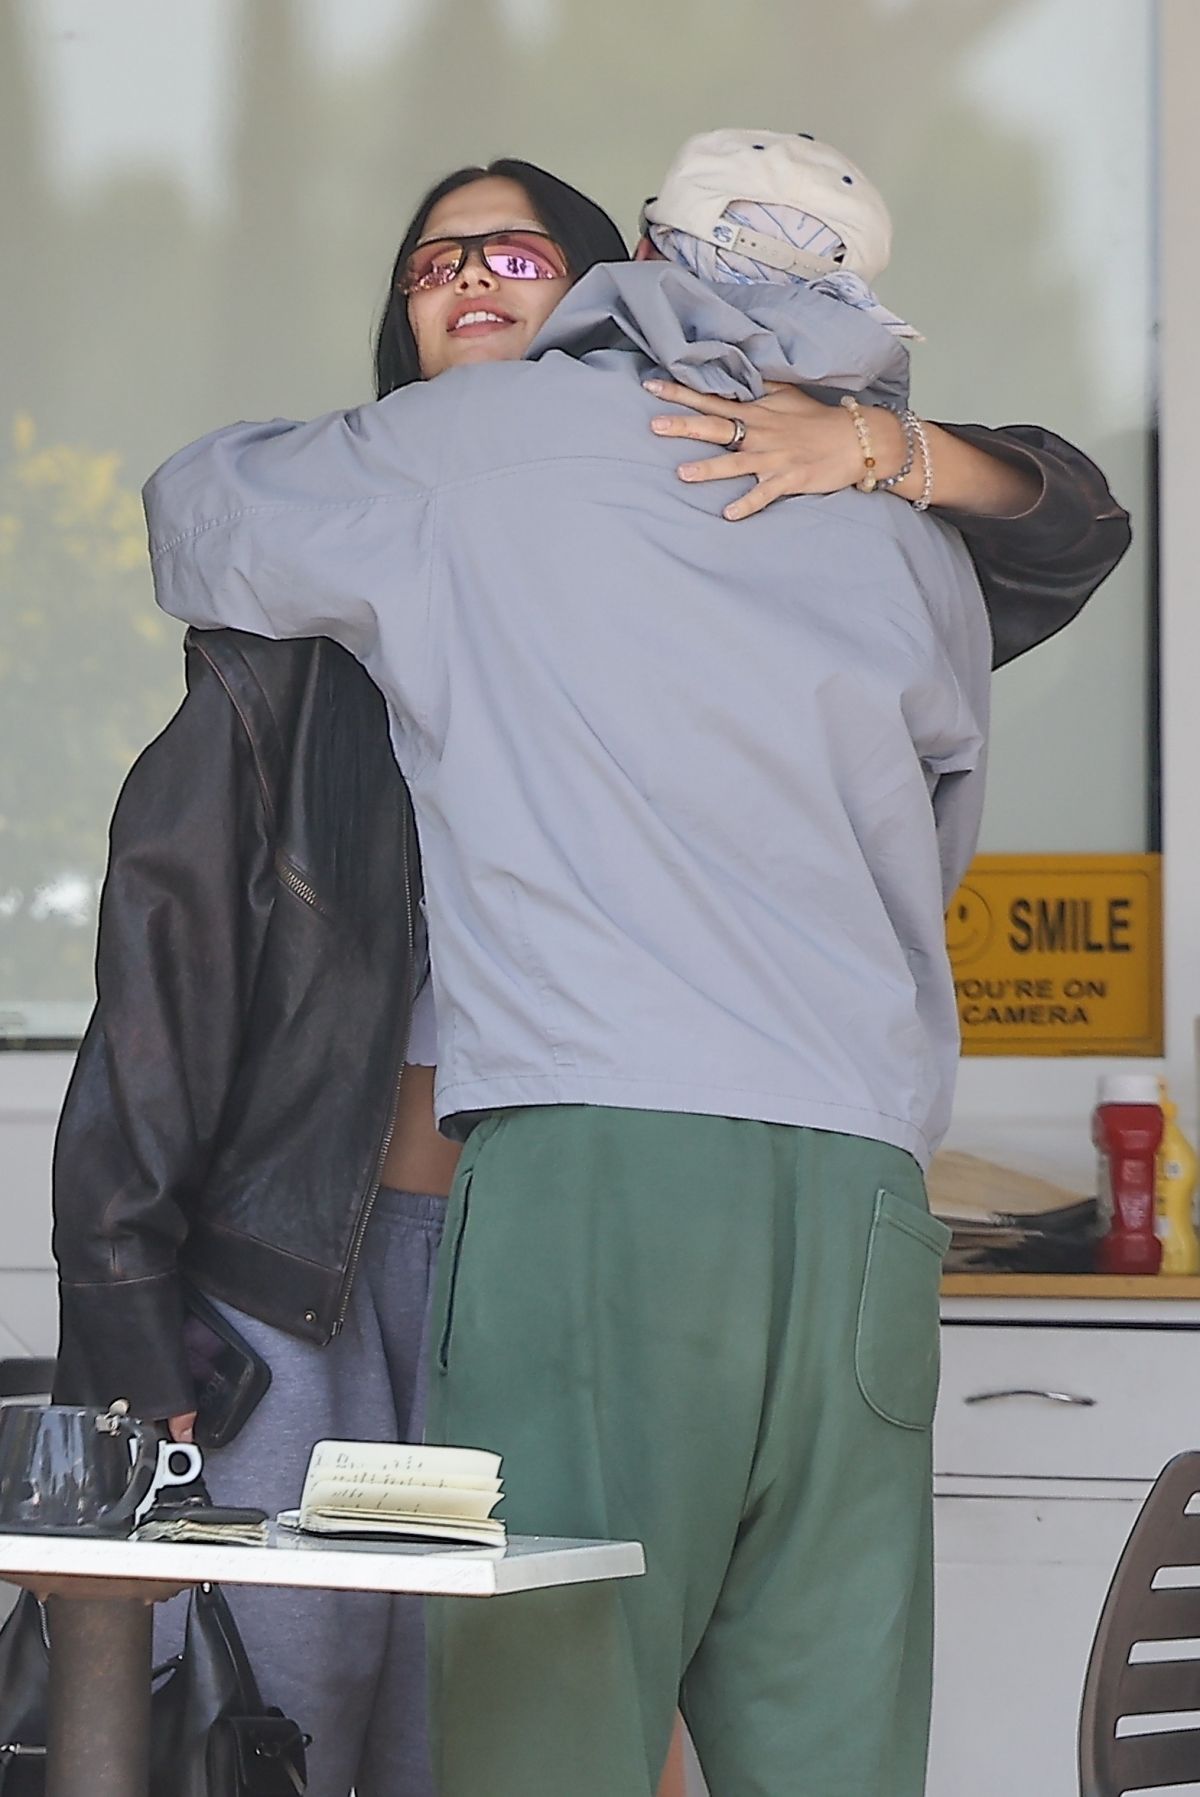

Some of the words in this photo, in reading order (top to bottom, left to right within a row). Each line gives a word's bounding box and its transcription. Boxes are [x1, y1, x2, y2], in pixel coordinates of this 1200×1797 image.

[1009, 898, 1132, 954] SMILE
[1063, 979, 1107, 999] ON
[962, 1005, 1090, 1024] CAMERA
